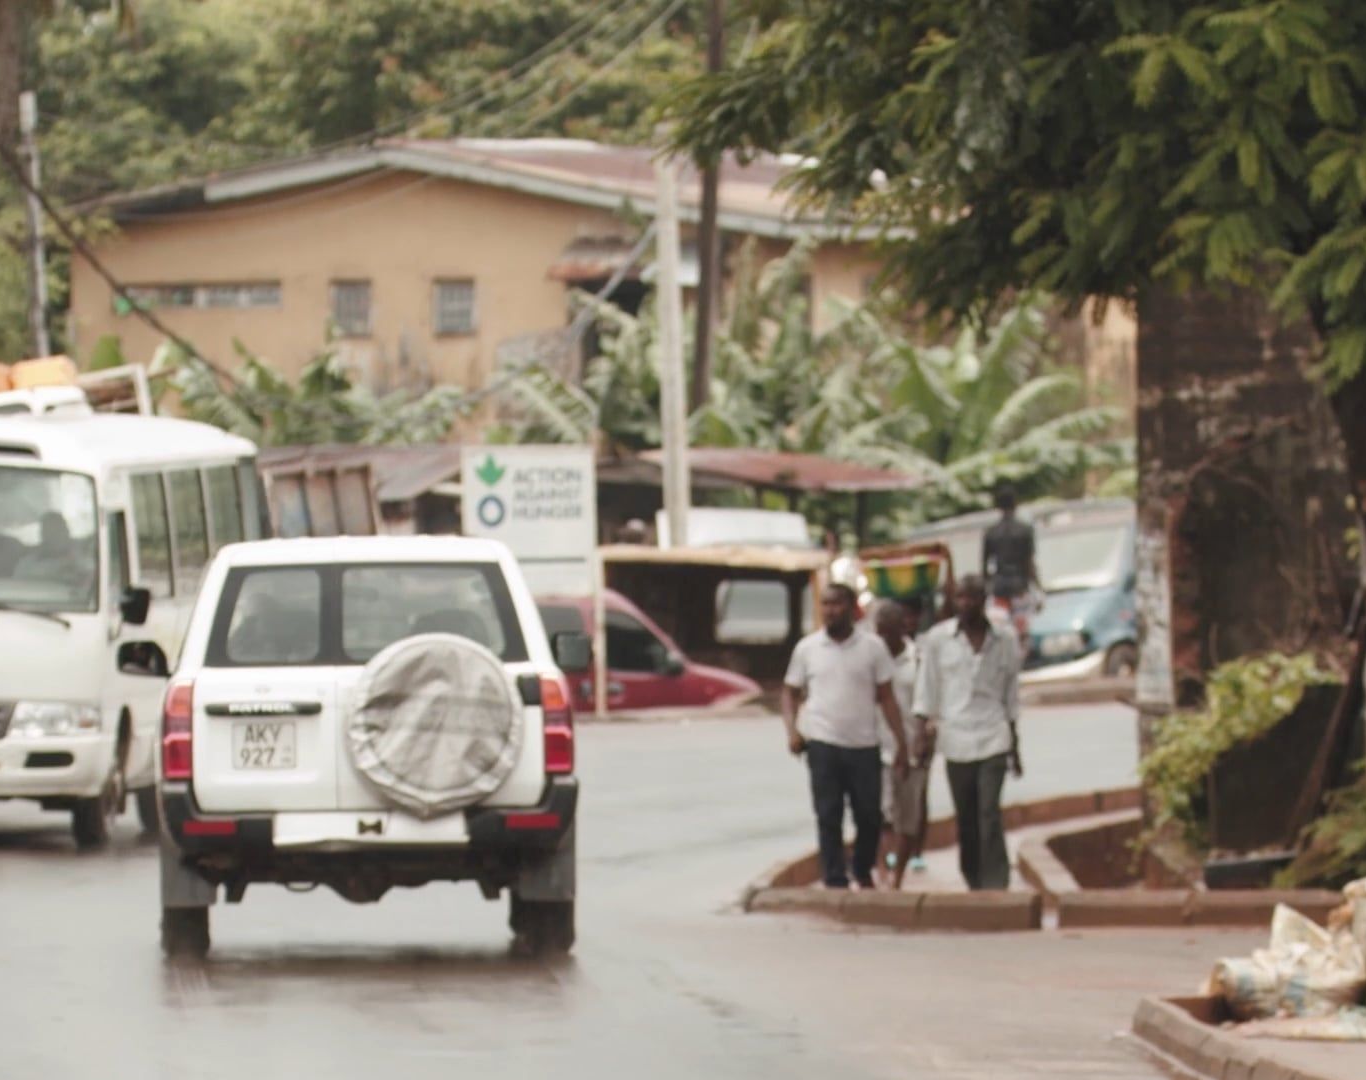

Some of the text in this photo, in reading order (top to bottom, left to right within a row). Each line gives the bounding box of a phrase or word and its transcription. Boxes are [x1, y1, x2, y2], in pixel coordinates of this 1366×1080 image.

[513, 466, 583, 484] ACTION
[513, 504, 583, 520] HUNGER
[244, 721, 283, 743] AKY
[240, 746, 275, 768] 927
